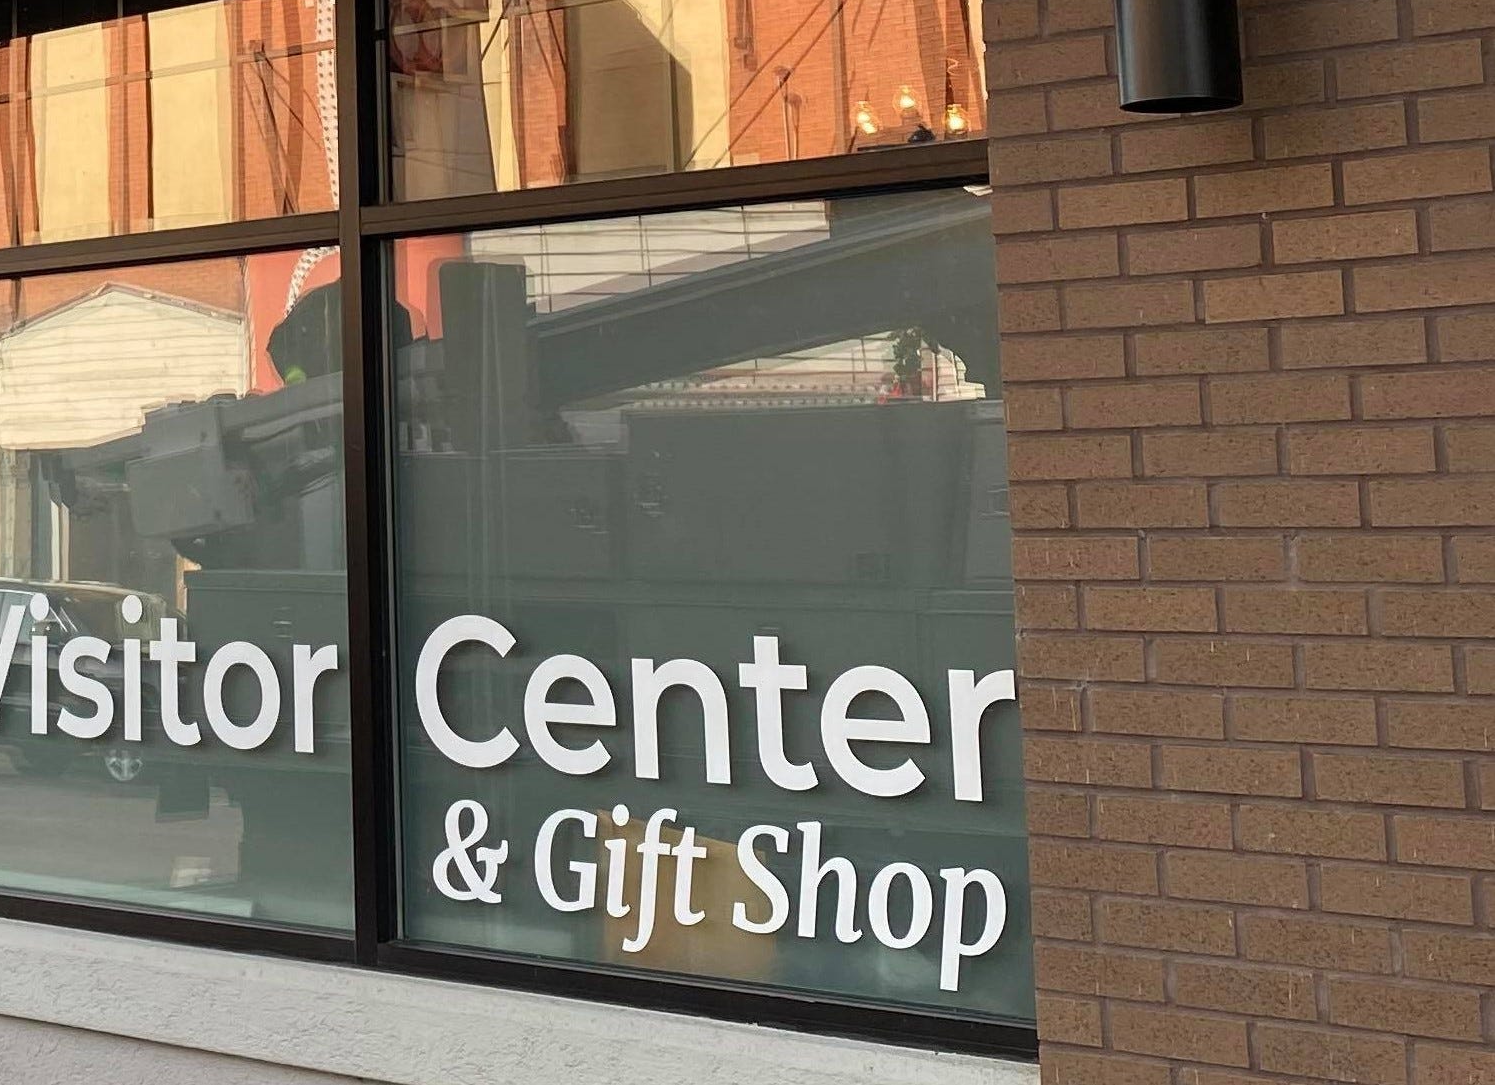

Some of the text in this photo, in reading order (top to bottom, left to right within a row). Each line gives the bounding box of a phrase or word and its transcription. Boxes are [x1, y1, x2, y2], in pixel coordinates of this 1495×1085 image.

[415, 614, 1016, 802] Center
[432, 799, 1007, 992] & Gift Shop
